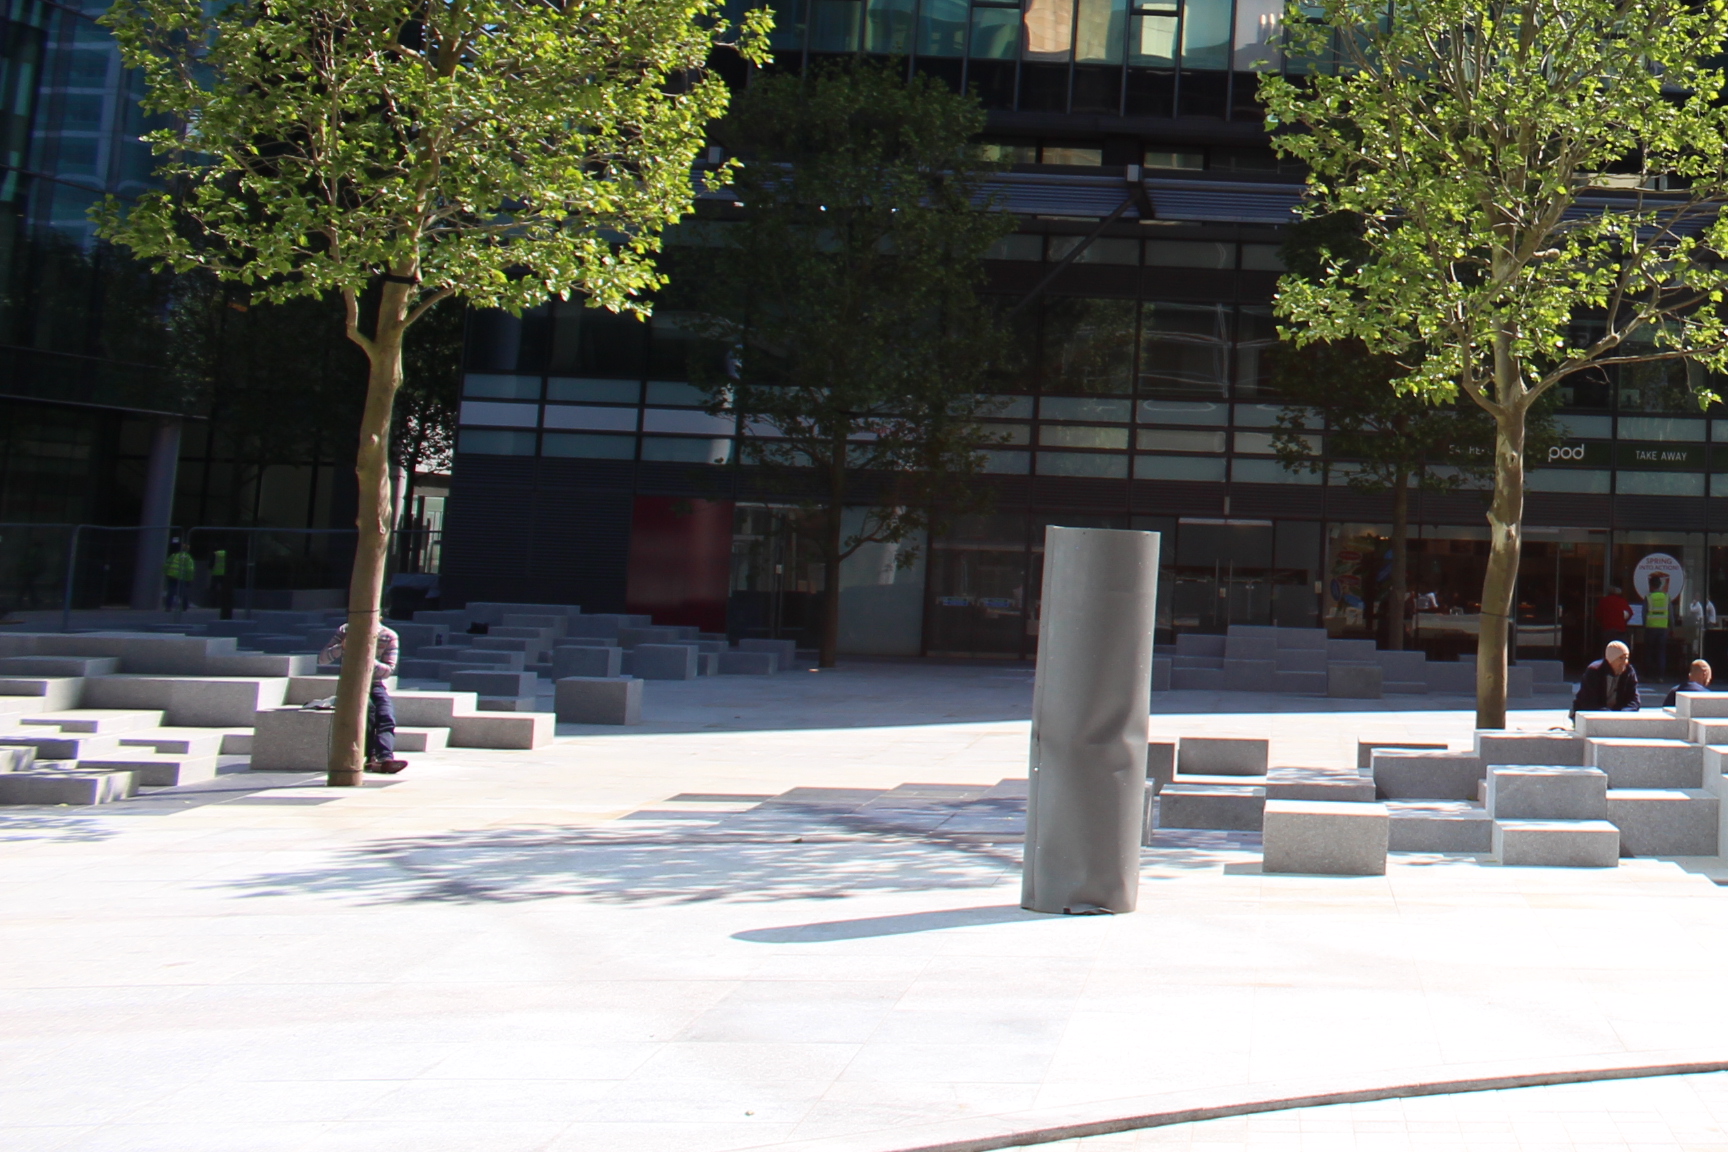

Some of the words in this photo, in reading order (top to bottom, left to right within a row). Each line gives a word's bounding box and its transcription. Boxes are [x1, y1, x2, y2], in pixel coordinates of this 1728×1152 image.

[1548, 443, 1585, 462] pod
[1635, 450, 1657, 461] TAKE
[1660, 451, 1688, 462] AWAY
